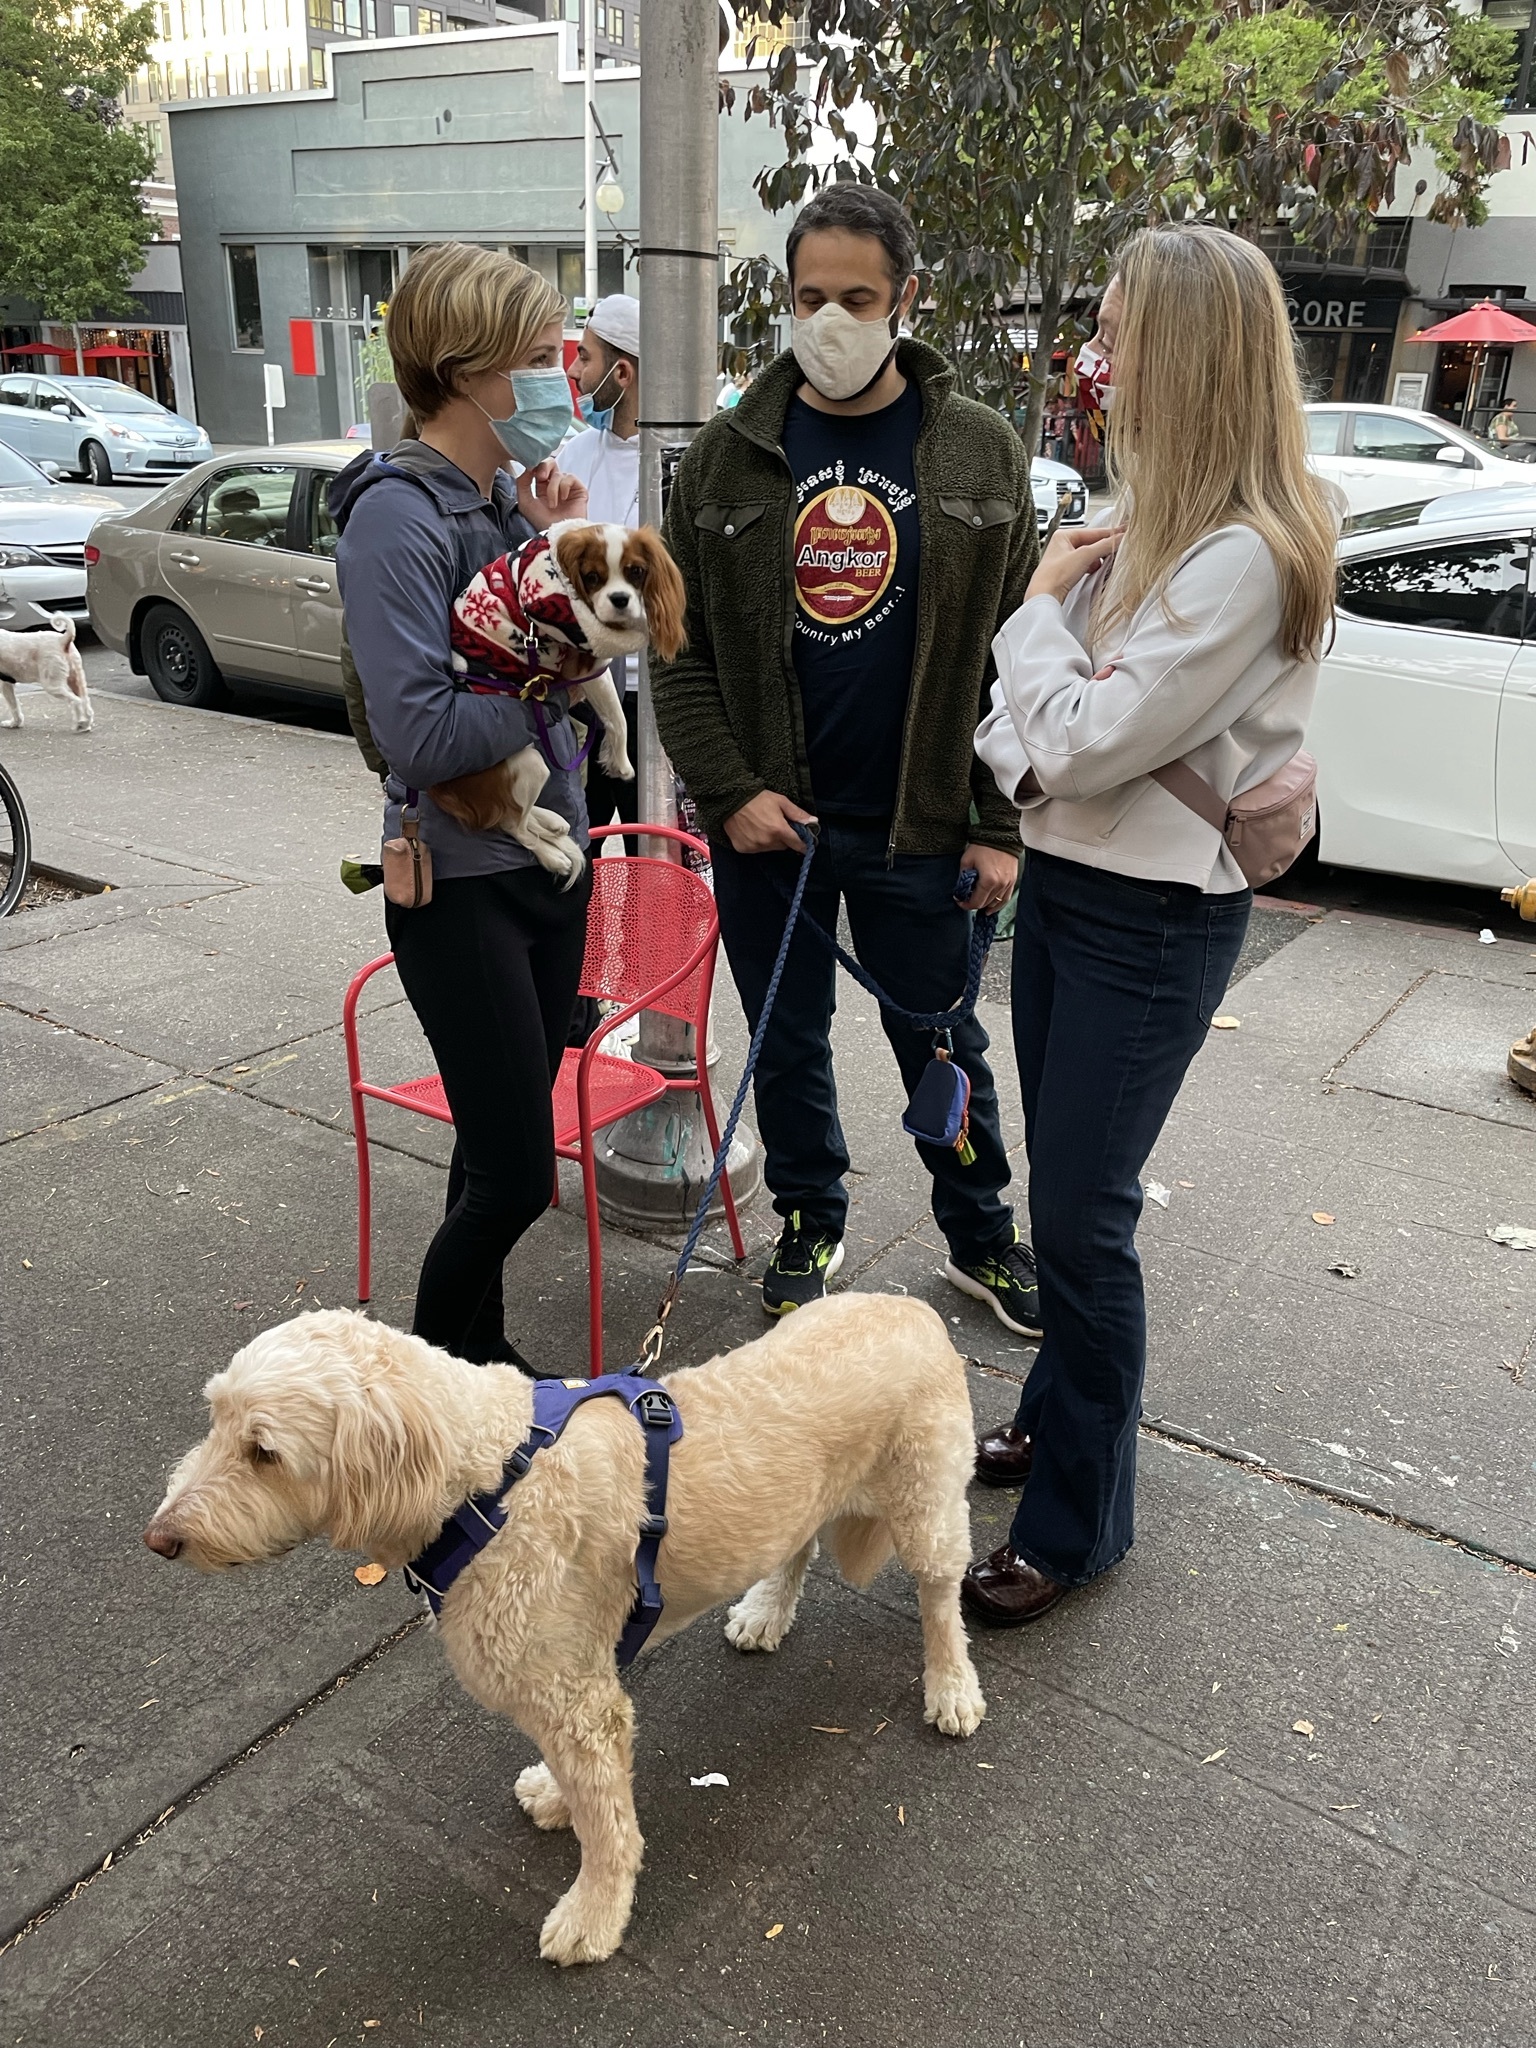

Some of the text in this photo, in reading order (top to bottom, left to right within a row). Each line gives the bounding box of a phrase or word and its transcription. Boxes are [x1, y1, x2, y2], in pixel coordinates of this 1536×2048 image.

[1286, 300, 1366, 327] CORE
[796, 544, 888, 573] Angkor
[855, 568, 881, 577] BEER
[842, 628, 861, 642] My
